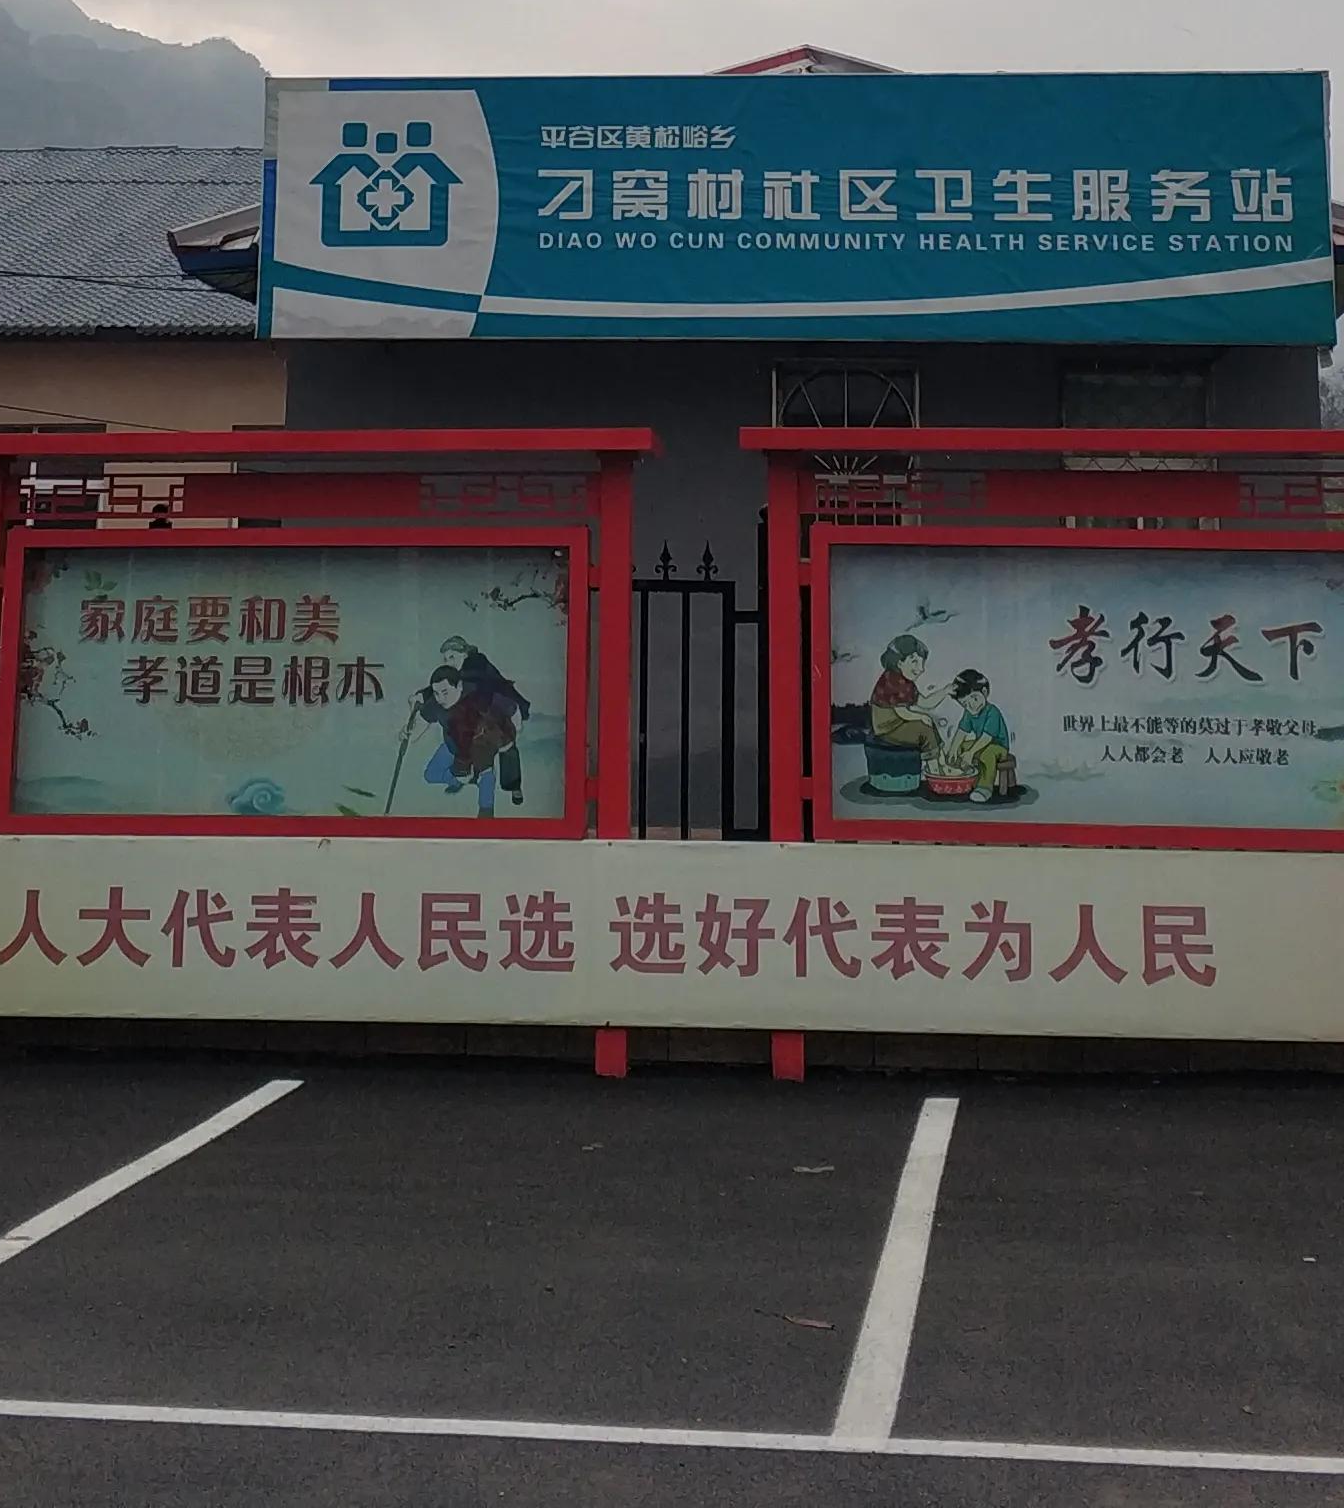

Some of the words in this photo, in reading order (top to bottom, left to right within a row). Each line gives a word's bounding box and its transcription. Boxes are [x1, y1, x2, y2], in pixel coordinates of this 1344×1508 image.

[541, 125, 736, 149] 平谷区黄松峪乡
[538, 168, 1293, 222] 刁窝村社区卫生服务站
[539, 233, 602, 249] DIAO
[615, 233, 657, 249] WO
[669, 233, 724, 249] CUN
[737, 233, 905, 250] COMMUNITY
[920, 234, 1024, 251] HEALTH
[1038, 234, 1154, 251] SERVICE
[1169, 234, 1293, 252] STATION
[78, 594, 342, 644] 家庭要和美
[1048, 606, 1323, 683] 孝行天下
[120, 654, 386, 707] 孝道是根本
[1100, 745, 1184, 764] 人人都会老
[1204, 746, 1290, 766] 人人应敬老
[608, 890, 1217, 986] 选好代表为人民
